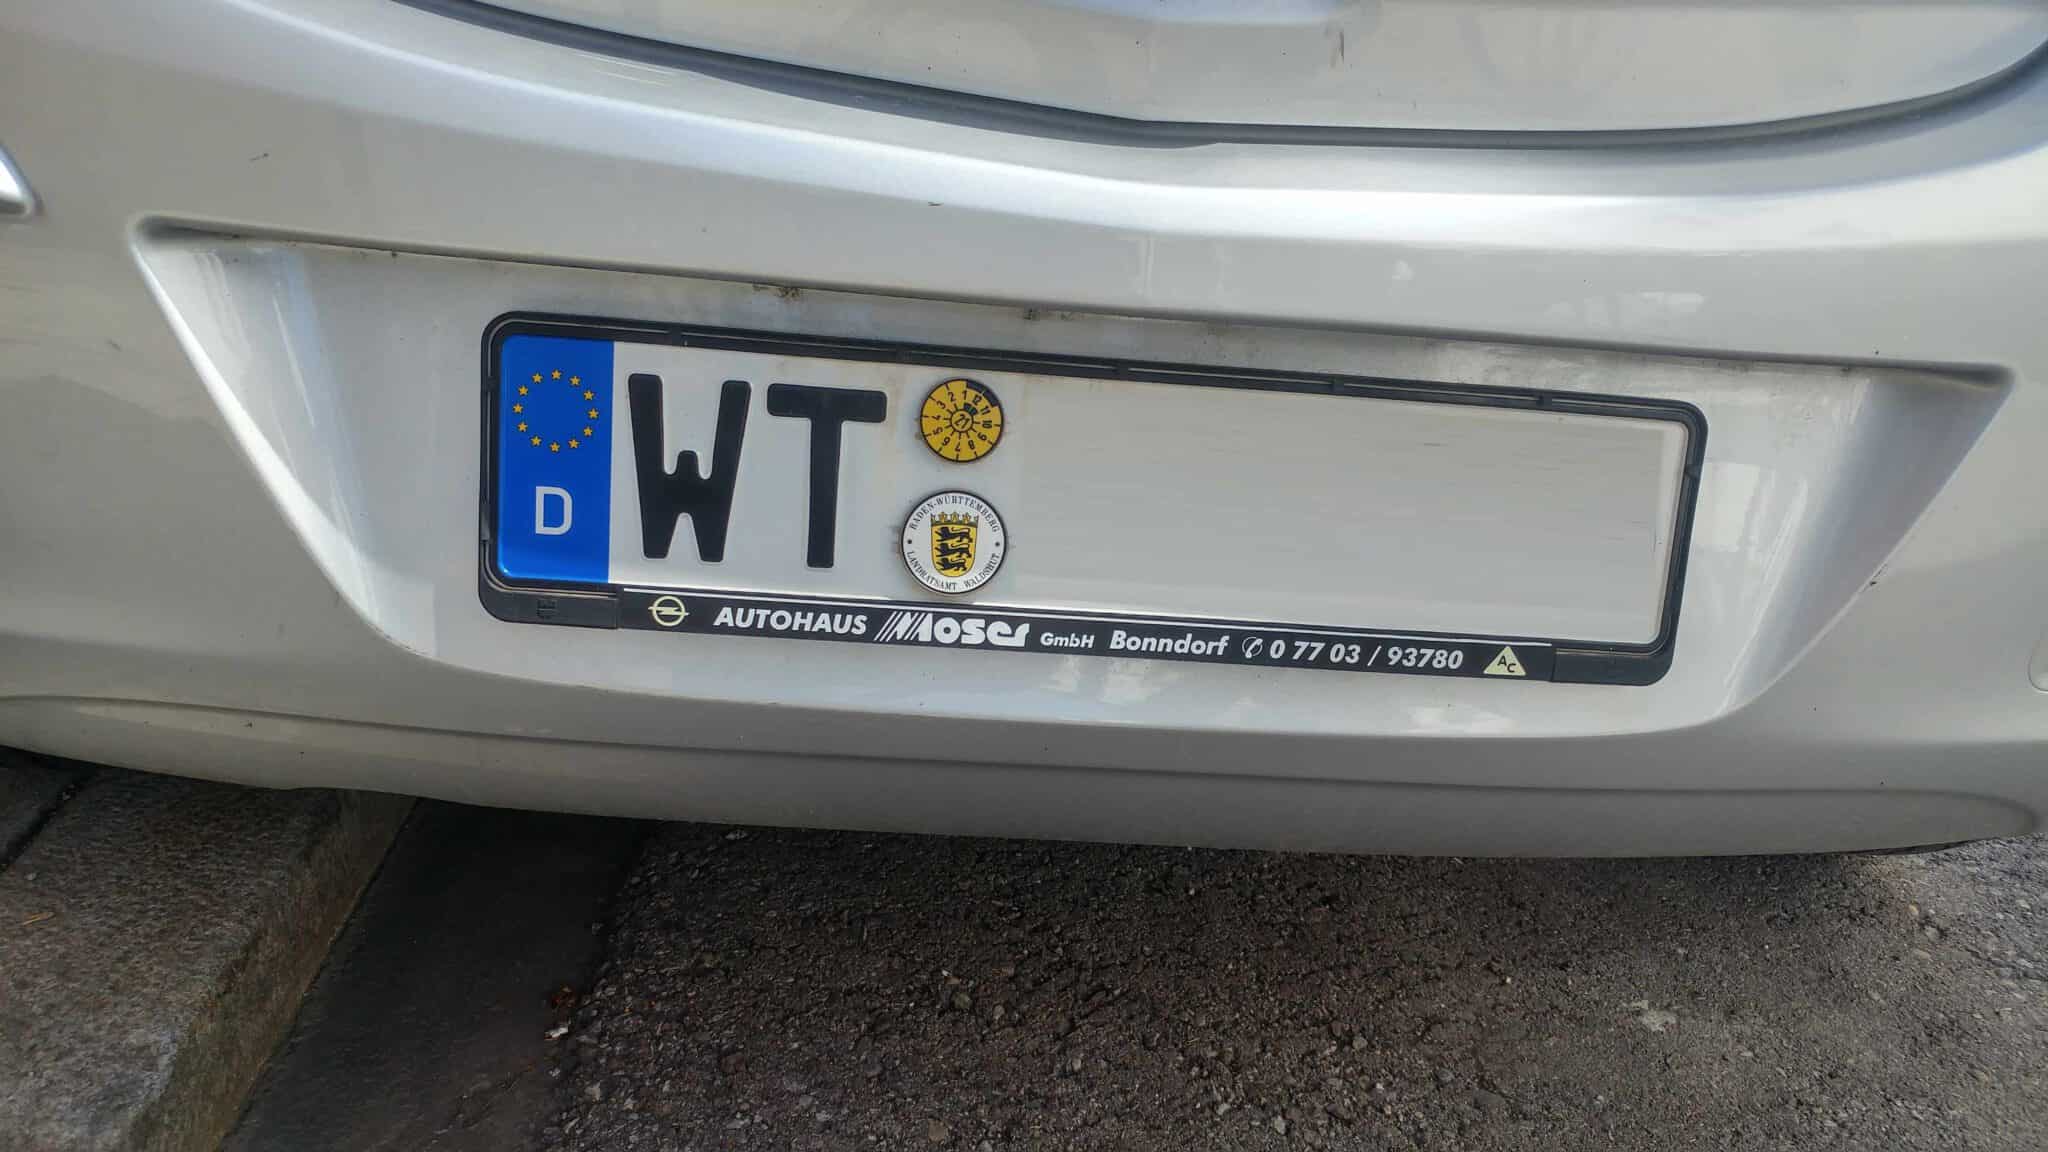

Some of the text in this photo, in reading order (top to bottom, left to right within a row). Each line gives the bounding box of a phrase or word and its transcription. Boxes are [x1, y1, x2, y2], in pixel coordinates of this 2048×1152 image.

[948, 391, 956, 402] 2
[936, 400, 946, 409] 3
[953, 413, 970, 429] 21
[982, 420, 993, 429] 10
[932, 426, 943, 435] 5
[967, 439, 975, 450] 8
[628, 373, 888, 568] WT
[535, 486, 573, 536] D
[907, 550, 1001, 591] LANDRATSAMT WALDSHUT
[712, 606, 868, 635] AUTOHAUS
[1039, 631, 1096, 649] GmbH
[1109, 629, 1230, 656] Bonndorf
[1386, 646, 1464, 670] 93780
